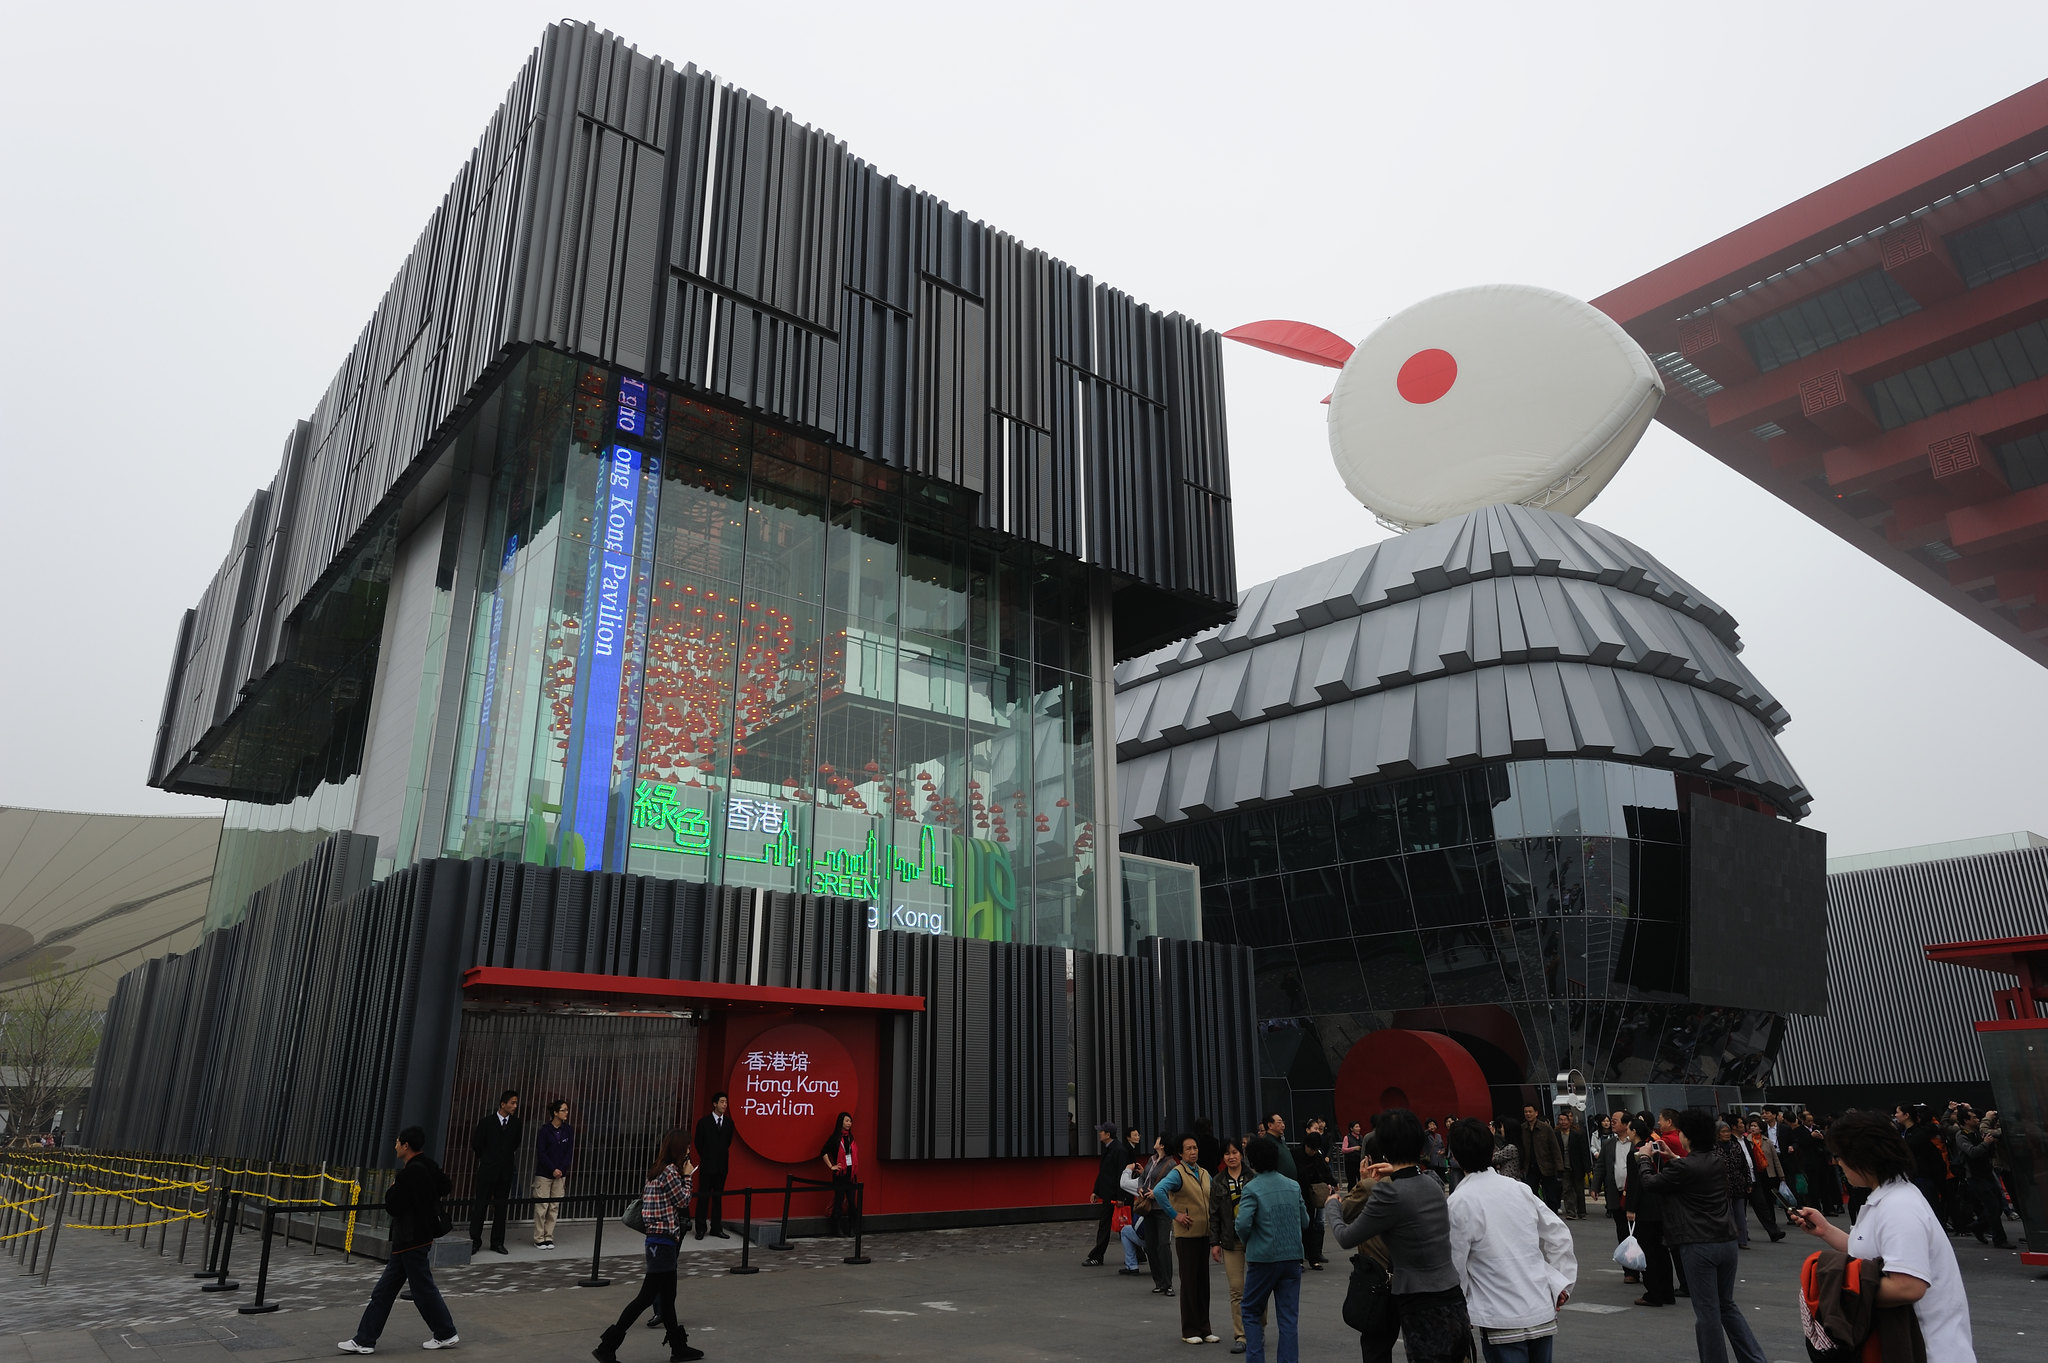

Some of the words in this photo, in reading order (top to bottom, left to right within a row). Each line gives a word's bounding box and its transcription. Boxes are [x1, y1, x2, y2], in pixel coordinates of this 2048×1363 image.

[603, 493, 634, 556] Kong
[596, 560, 628, 656] Pavilion
[726, 797, 783, 835] 香港
[808, 870, 878, 900] GREEN
[891, 904, 942, 935] Kong
[743, 1051, 811, 1072] 香港馆
[746, 1074, 793, 1097] Hong
[797, 1075, 840, 1098] Kong
[743, 1098, 815, 1117] Pavilion
